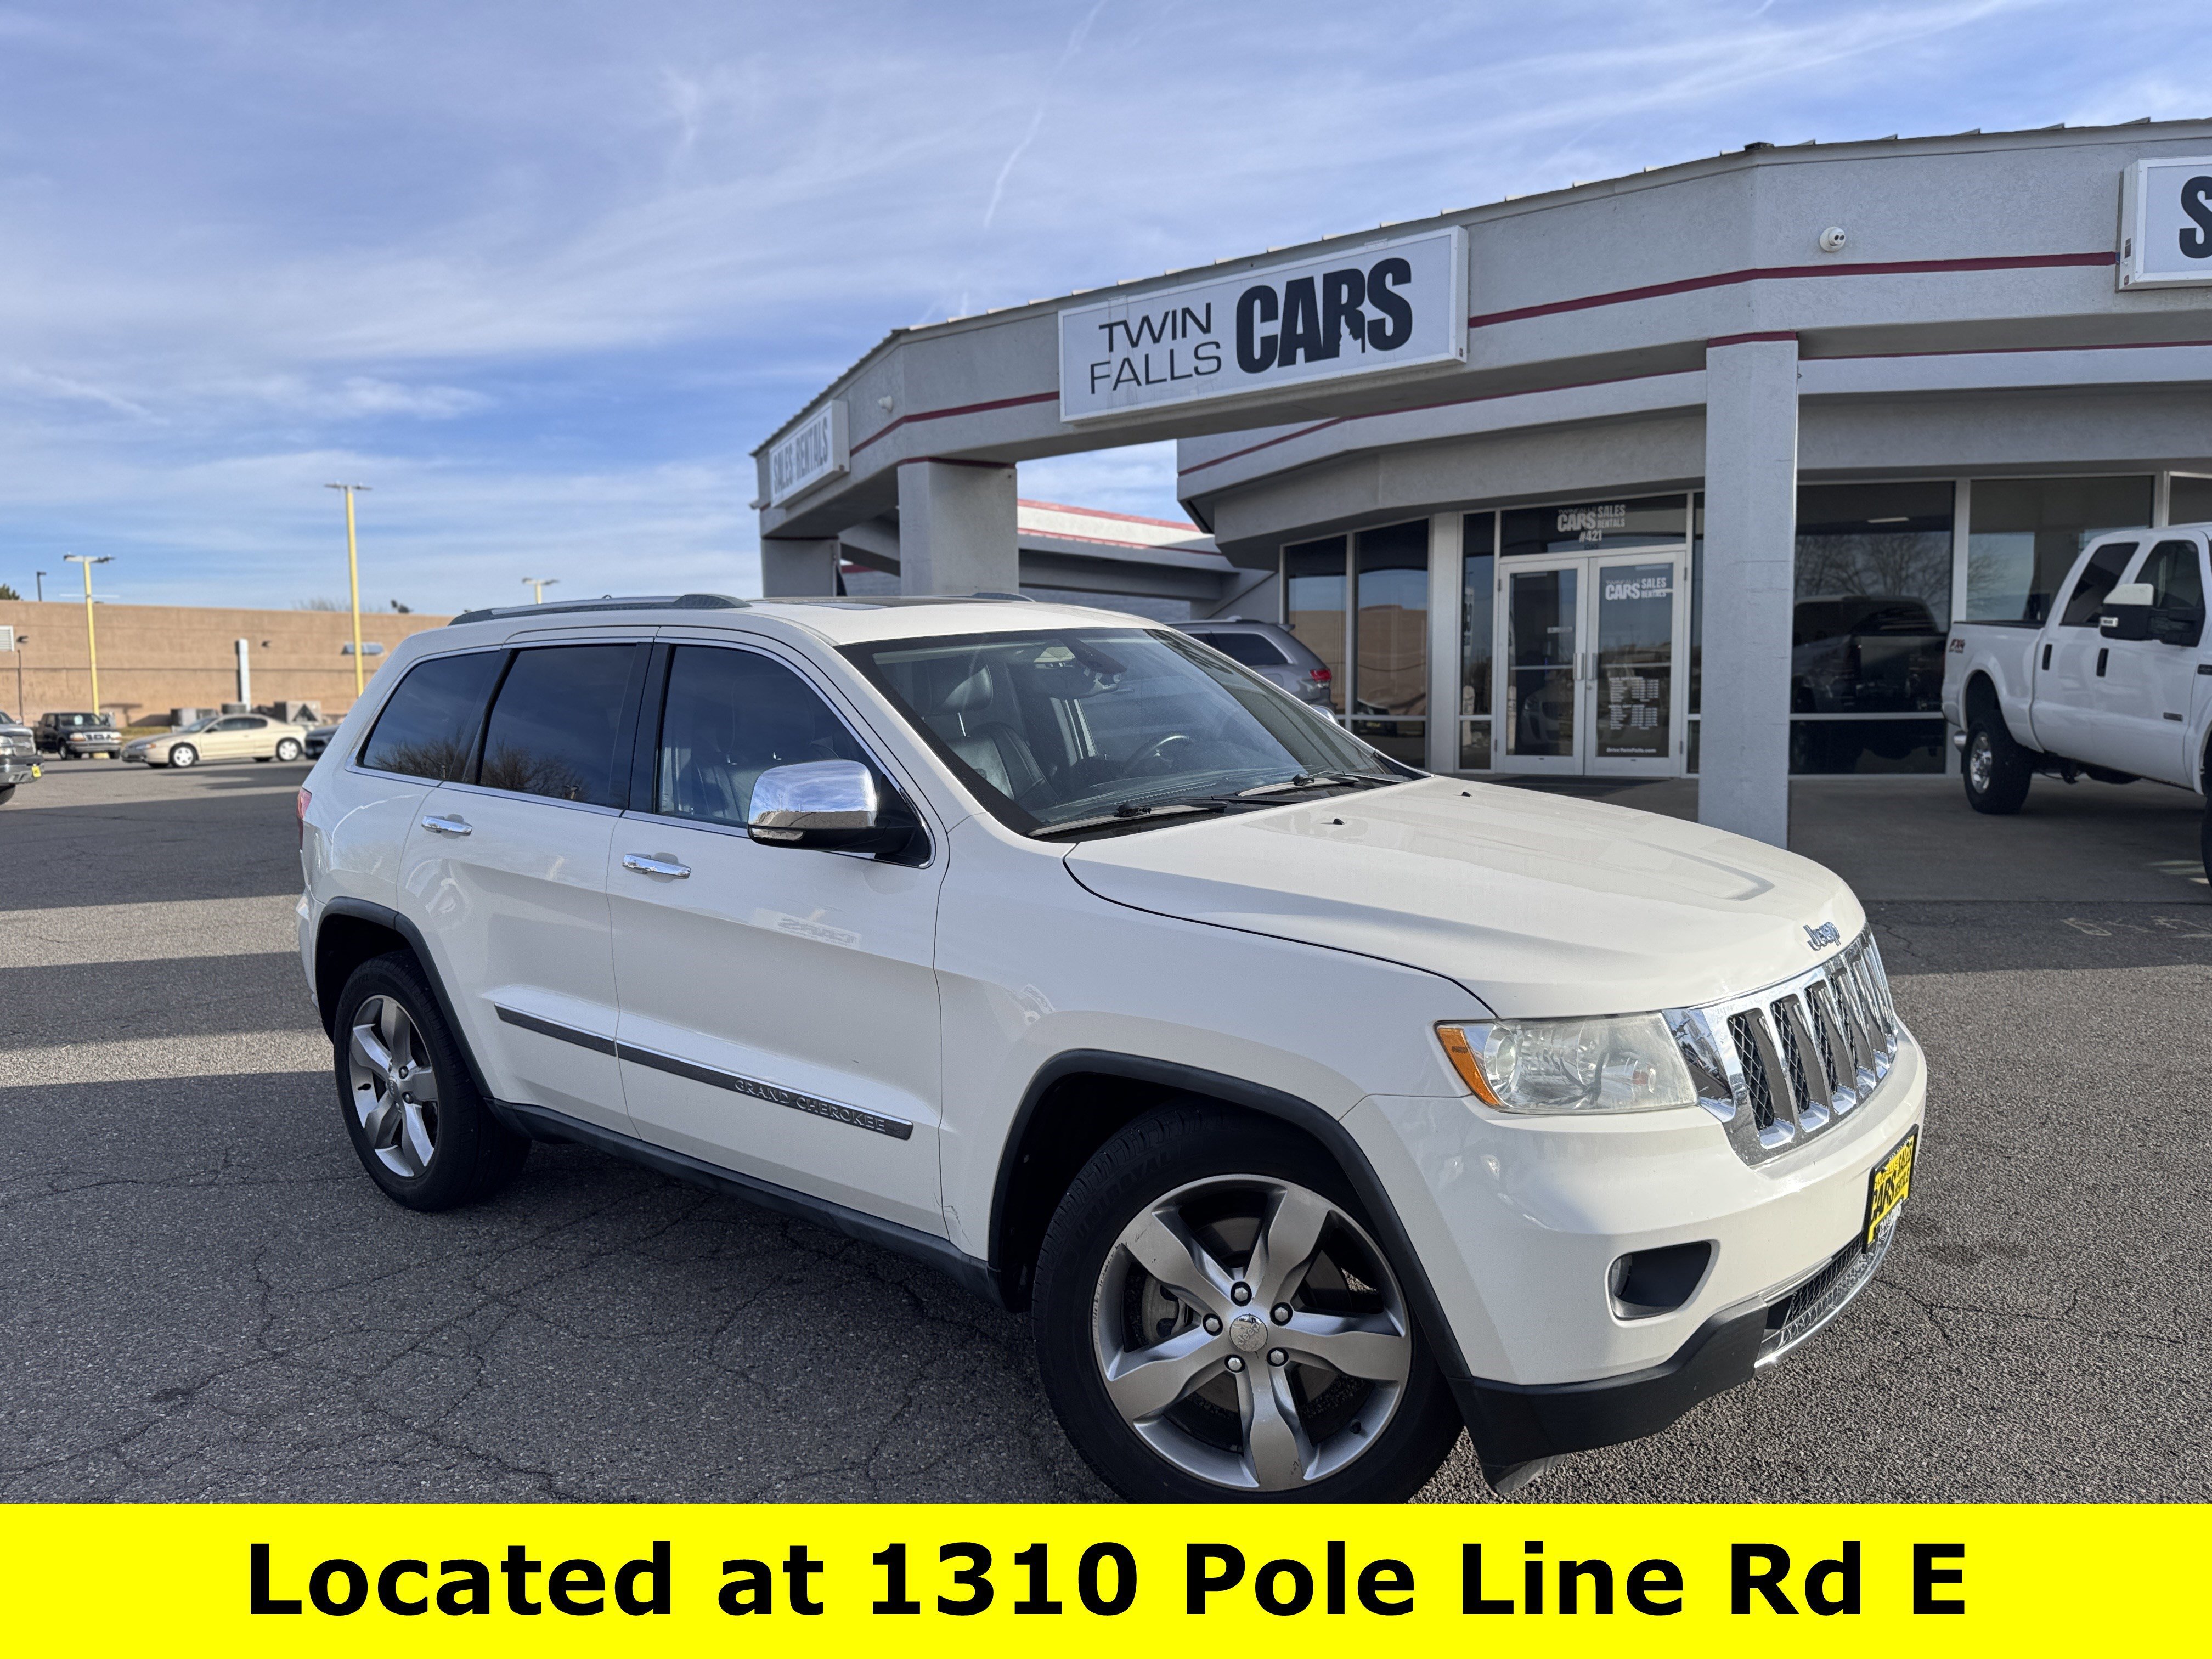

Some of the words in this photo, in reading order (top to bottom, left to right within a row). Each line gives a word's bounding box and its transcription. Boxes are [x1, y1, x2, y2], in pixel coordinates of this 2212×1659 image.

[1236, 258, 1413, 374] CARS
[1098, 302, 1211, 353] TWIN
[1090, 341, 1221, 394] FALLS
[1557, 511, 1596, 532] CARS
[1598, 504, 1626, 518] SALES
[1597, 518, 1626, 529] RENTALS
[1579, 529, 1602, 543] #421
[1605, 583, 1641, 600] CARS
[1641, 577, 1667, 589] SALES
[1803, 922, 1841, 951] Jeep
[734, 1079, 791, 1104] GRAND
[795, 1097, 886, 1132] CHEROKEE
[1237, 1323, 1260, 1345] Jeep
